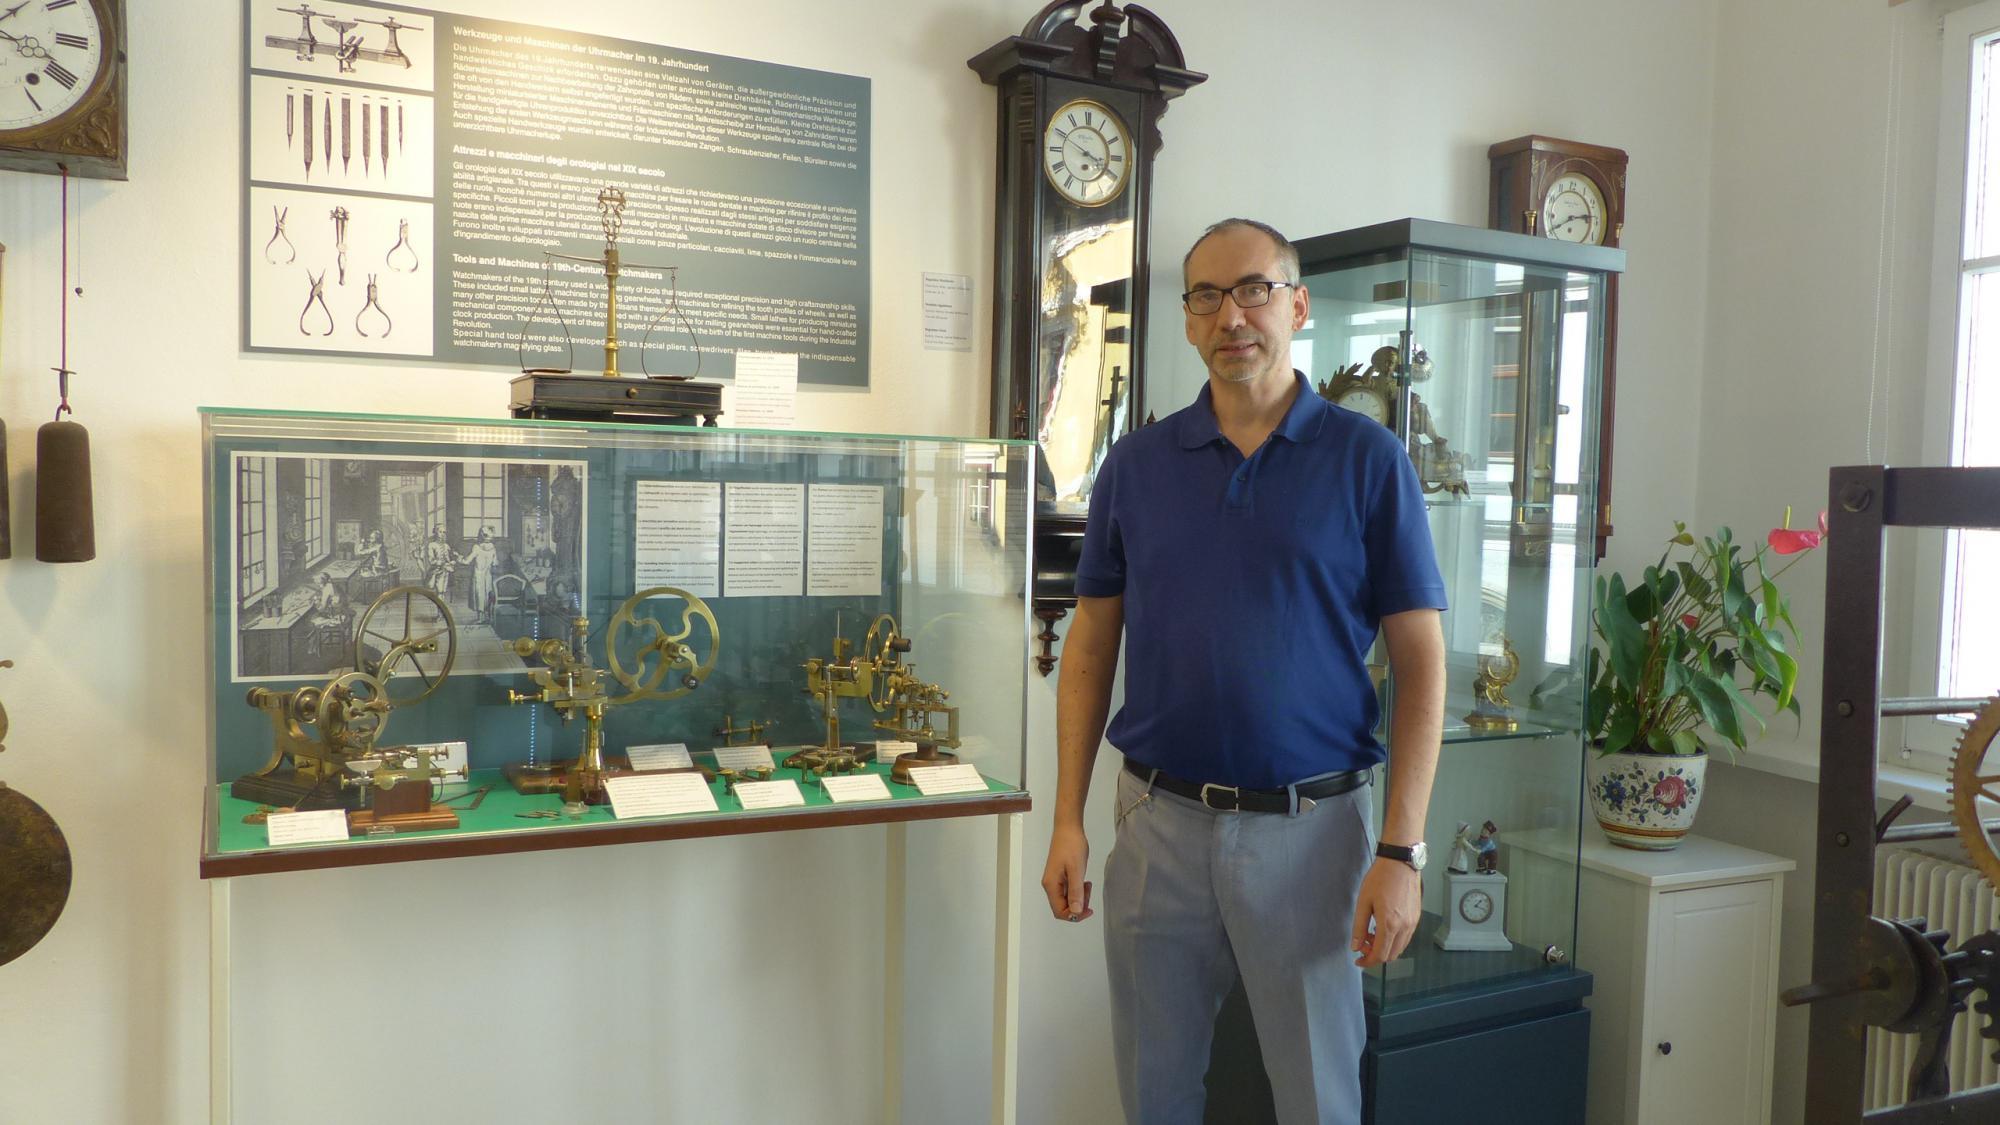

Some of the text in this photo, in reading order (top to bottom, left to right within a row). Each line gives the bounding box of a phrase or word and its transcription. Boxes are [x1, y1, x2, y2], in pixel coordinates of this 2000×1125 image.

[453, 26, 708, 72] Werkzeuge und Maschinen der Uhrmacher im 19. Jahrhundert
[453, 145, 486, 156] Attrezzi
[496, 152, 544, 163] macchinari
[545, 156, 567, 167] degli
[569, 160, 606, 171] orologiai
[622, 165, 636, 174] XIX
[637, 168, 665, 177] secolo
[453, 254, 476, 263] Tools
[497, 258, 539, 269] Machines
[618, 270, 662, 279] tchmakers
[452, 270, 502, 281] Watchmakers
[703, 293, 739, 301] exceptional
[783, 298, 797, 307] high
[798, 300, 839, 311] craftsmanship
[452, 280, 475, 288] These
[477, 282, 508, 291] included
[554, 289, 588, 297] machines
[623, 295, 663, 304] gearwheels,
[721, 302, 744, 312] refining
[804, 309, 826, 318] wheels,
[452, 291, 472, 300] many
[588, 300, 597, 309] by
[798, 318, 828, 327] producing
[452, 300, 495, 309] mechanical
[558, 308, 592, 316] machines
[705, 319, 726, 328] milling
[452, 319, 492, 328] Revolution.
[474, 311, 513, 320] production.
[623, 322, 646, 331] played
[799, 335, 818, 344] during
[452, 328, 482, 337] Special
[484, 330, 504, 338] hand
[666, 343, 687, 352] pliers,
[811, 353, 855, 362] indispensable
[543, 344, 563, 352] glass.
